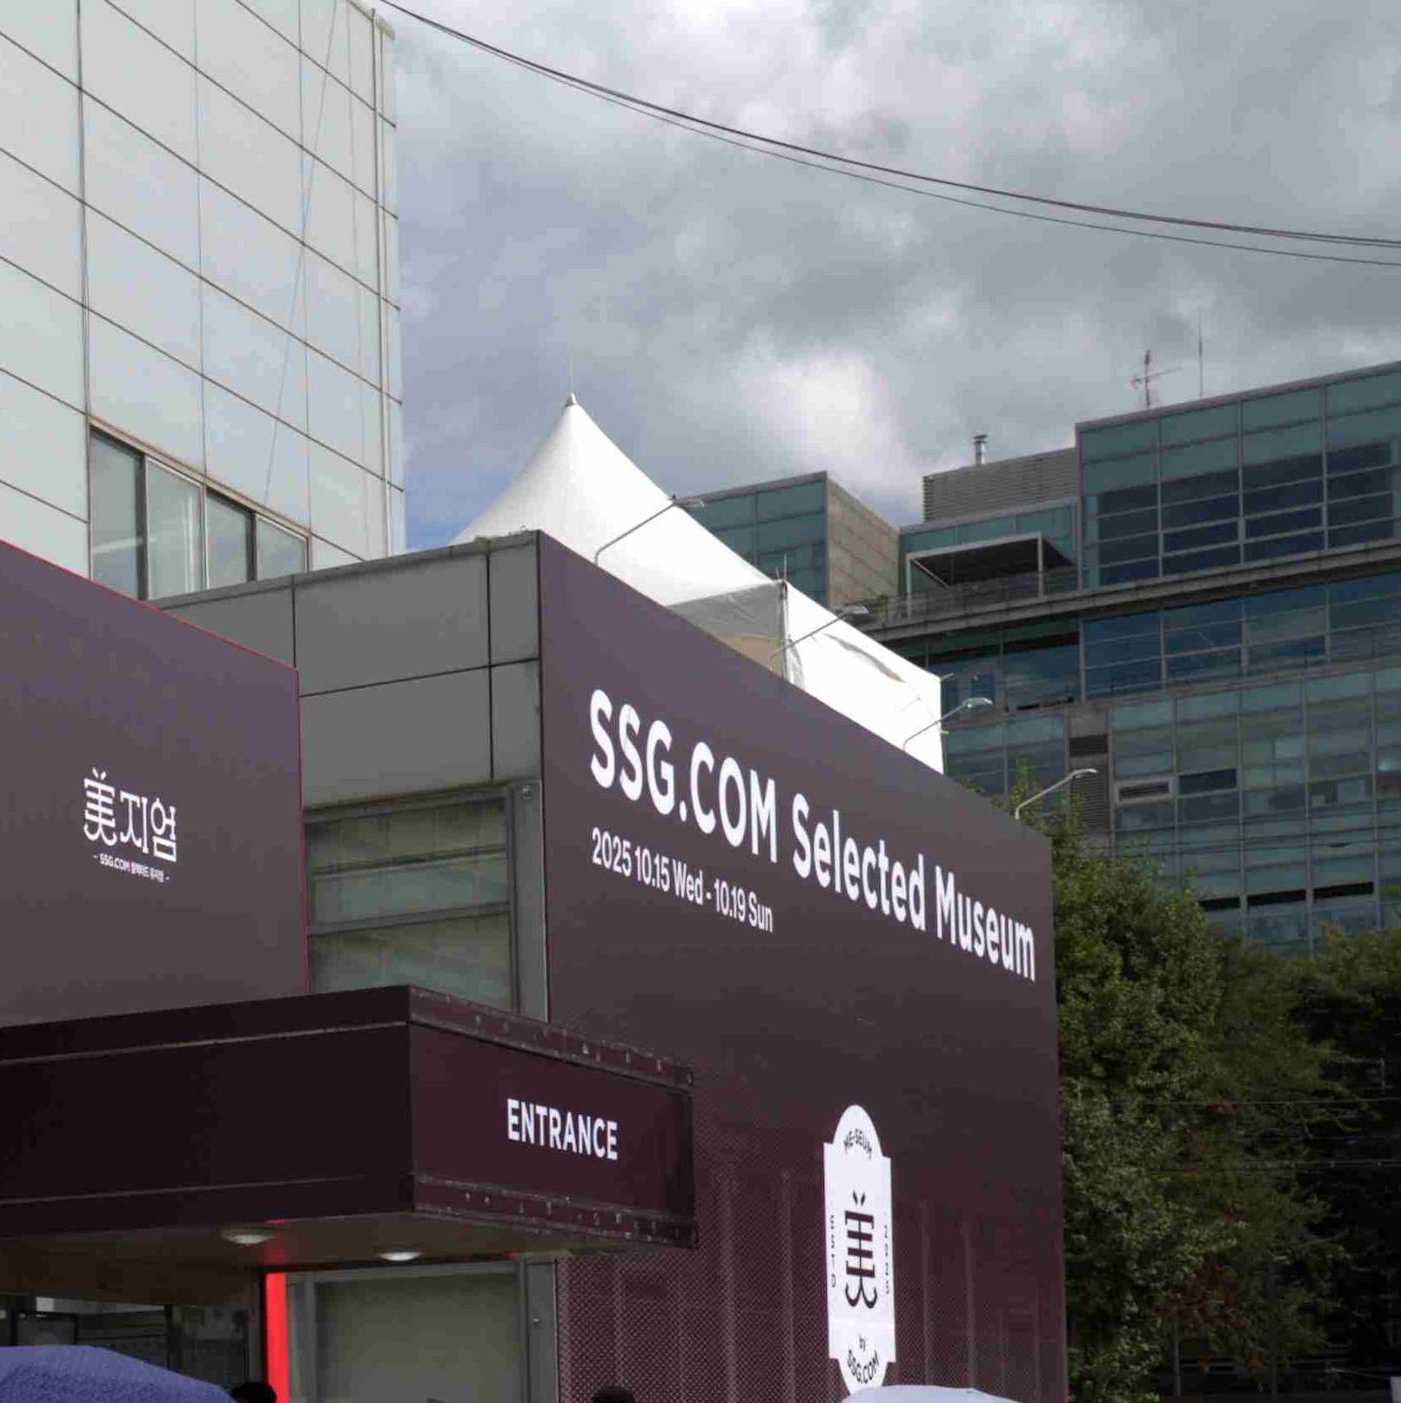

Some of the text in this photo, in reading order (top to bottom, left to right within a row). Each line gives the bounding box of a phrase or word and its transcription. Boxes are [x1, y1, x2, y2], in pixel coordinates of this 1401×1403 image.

[590, 689, 1035, 981] SSG.COM Selected Museum
[592, 828, 631, 878] 2025
[635, 846, 670, 893] 10.15
[673, 859, 703, 906] Wed
[714, 878, 746, 923] 10.19
[749, 893, 773, 933] Sun
[507, 1098, 618, 1161] ENTRANCE
[847, 1349, 880, 1385] SSG.COM
